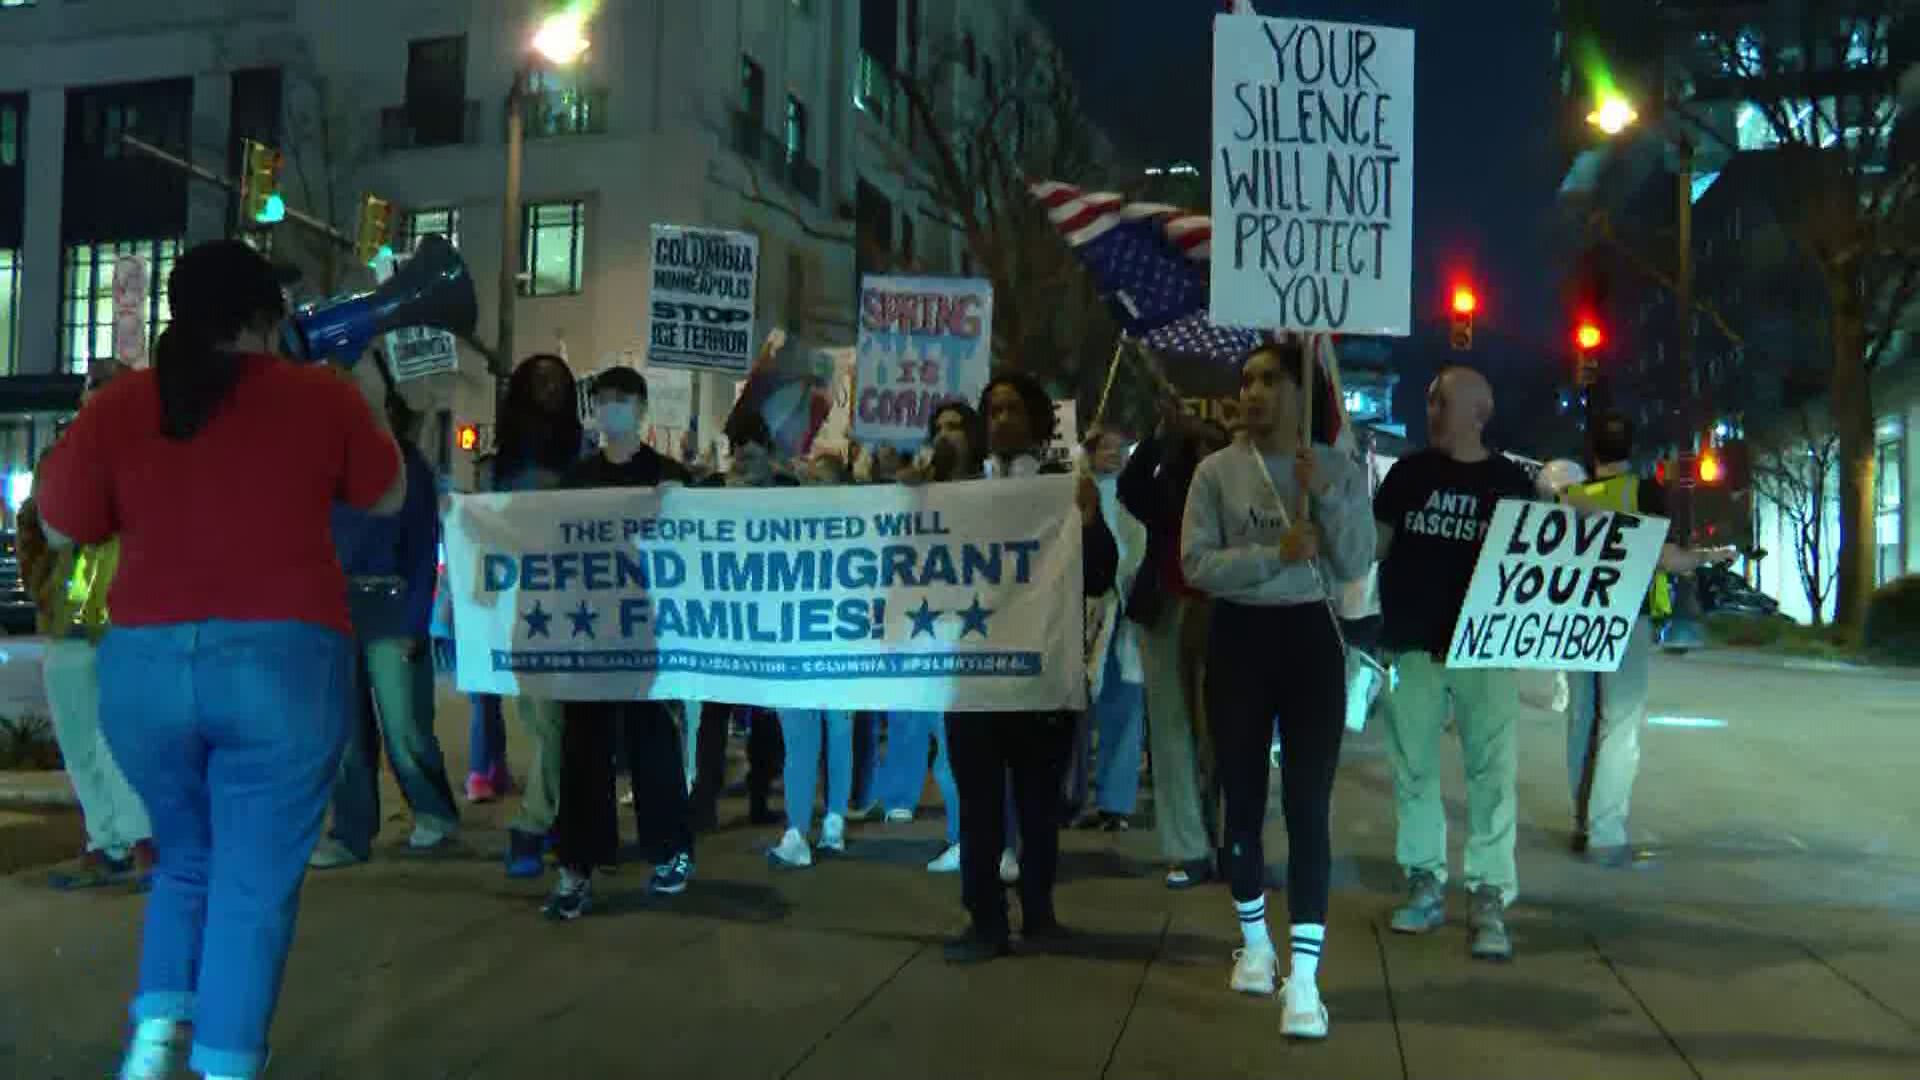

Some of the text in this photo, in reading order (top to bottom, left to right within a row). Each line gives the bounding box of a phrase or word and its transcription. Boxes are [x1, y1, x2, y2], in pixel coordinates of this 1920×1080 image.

[1264, 20, 1378, 88] YOUR
[1234, 82, 1392, 150] SILENCE
[1222, 147, 1399, 218] WILL NOT
[656, 236, 752, 272] COLUMBIA
[1234, 212, 1391, 280] PROTECT
[654, 269, 750, 299] MINNEAPOLIS
[1268, 273, 1349, 328] YOU
[653, 302, 749, 322] STOP
[863, 287, 981, 337] SPRING
[652, 322, 747, 352] ICE TERROR
[896, 358, 938, 383] IS
[1424, 488, 1477, 517] ANTI
[560, 510, 950, 543] THE PEOPLE UNITED WILL
[1506, 502, 1640, 561] LOVE
[484, 540, 1041, 592] DEFEND IMMIGRANT
[1496, 562, 1620, 607] YOUR
[619, 598, 886, 642] FAMILIES!
[1456, 613, 1628, 662] NEIGHBOR
